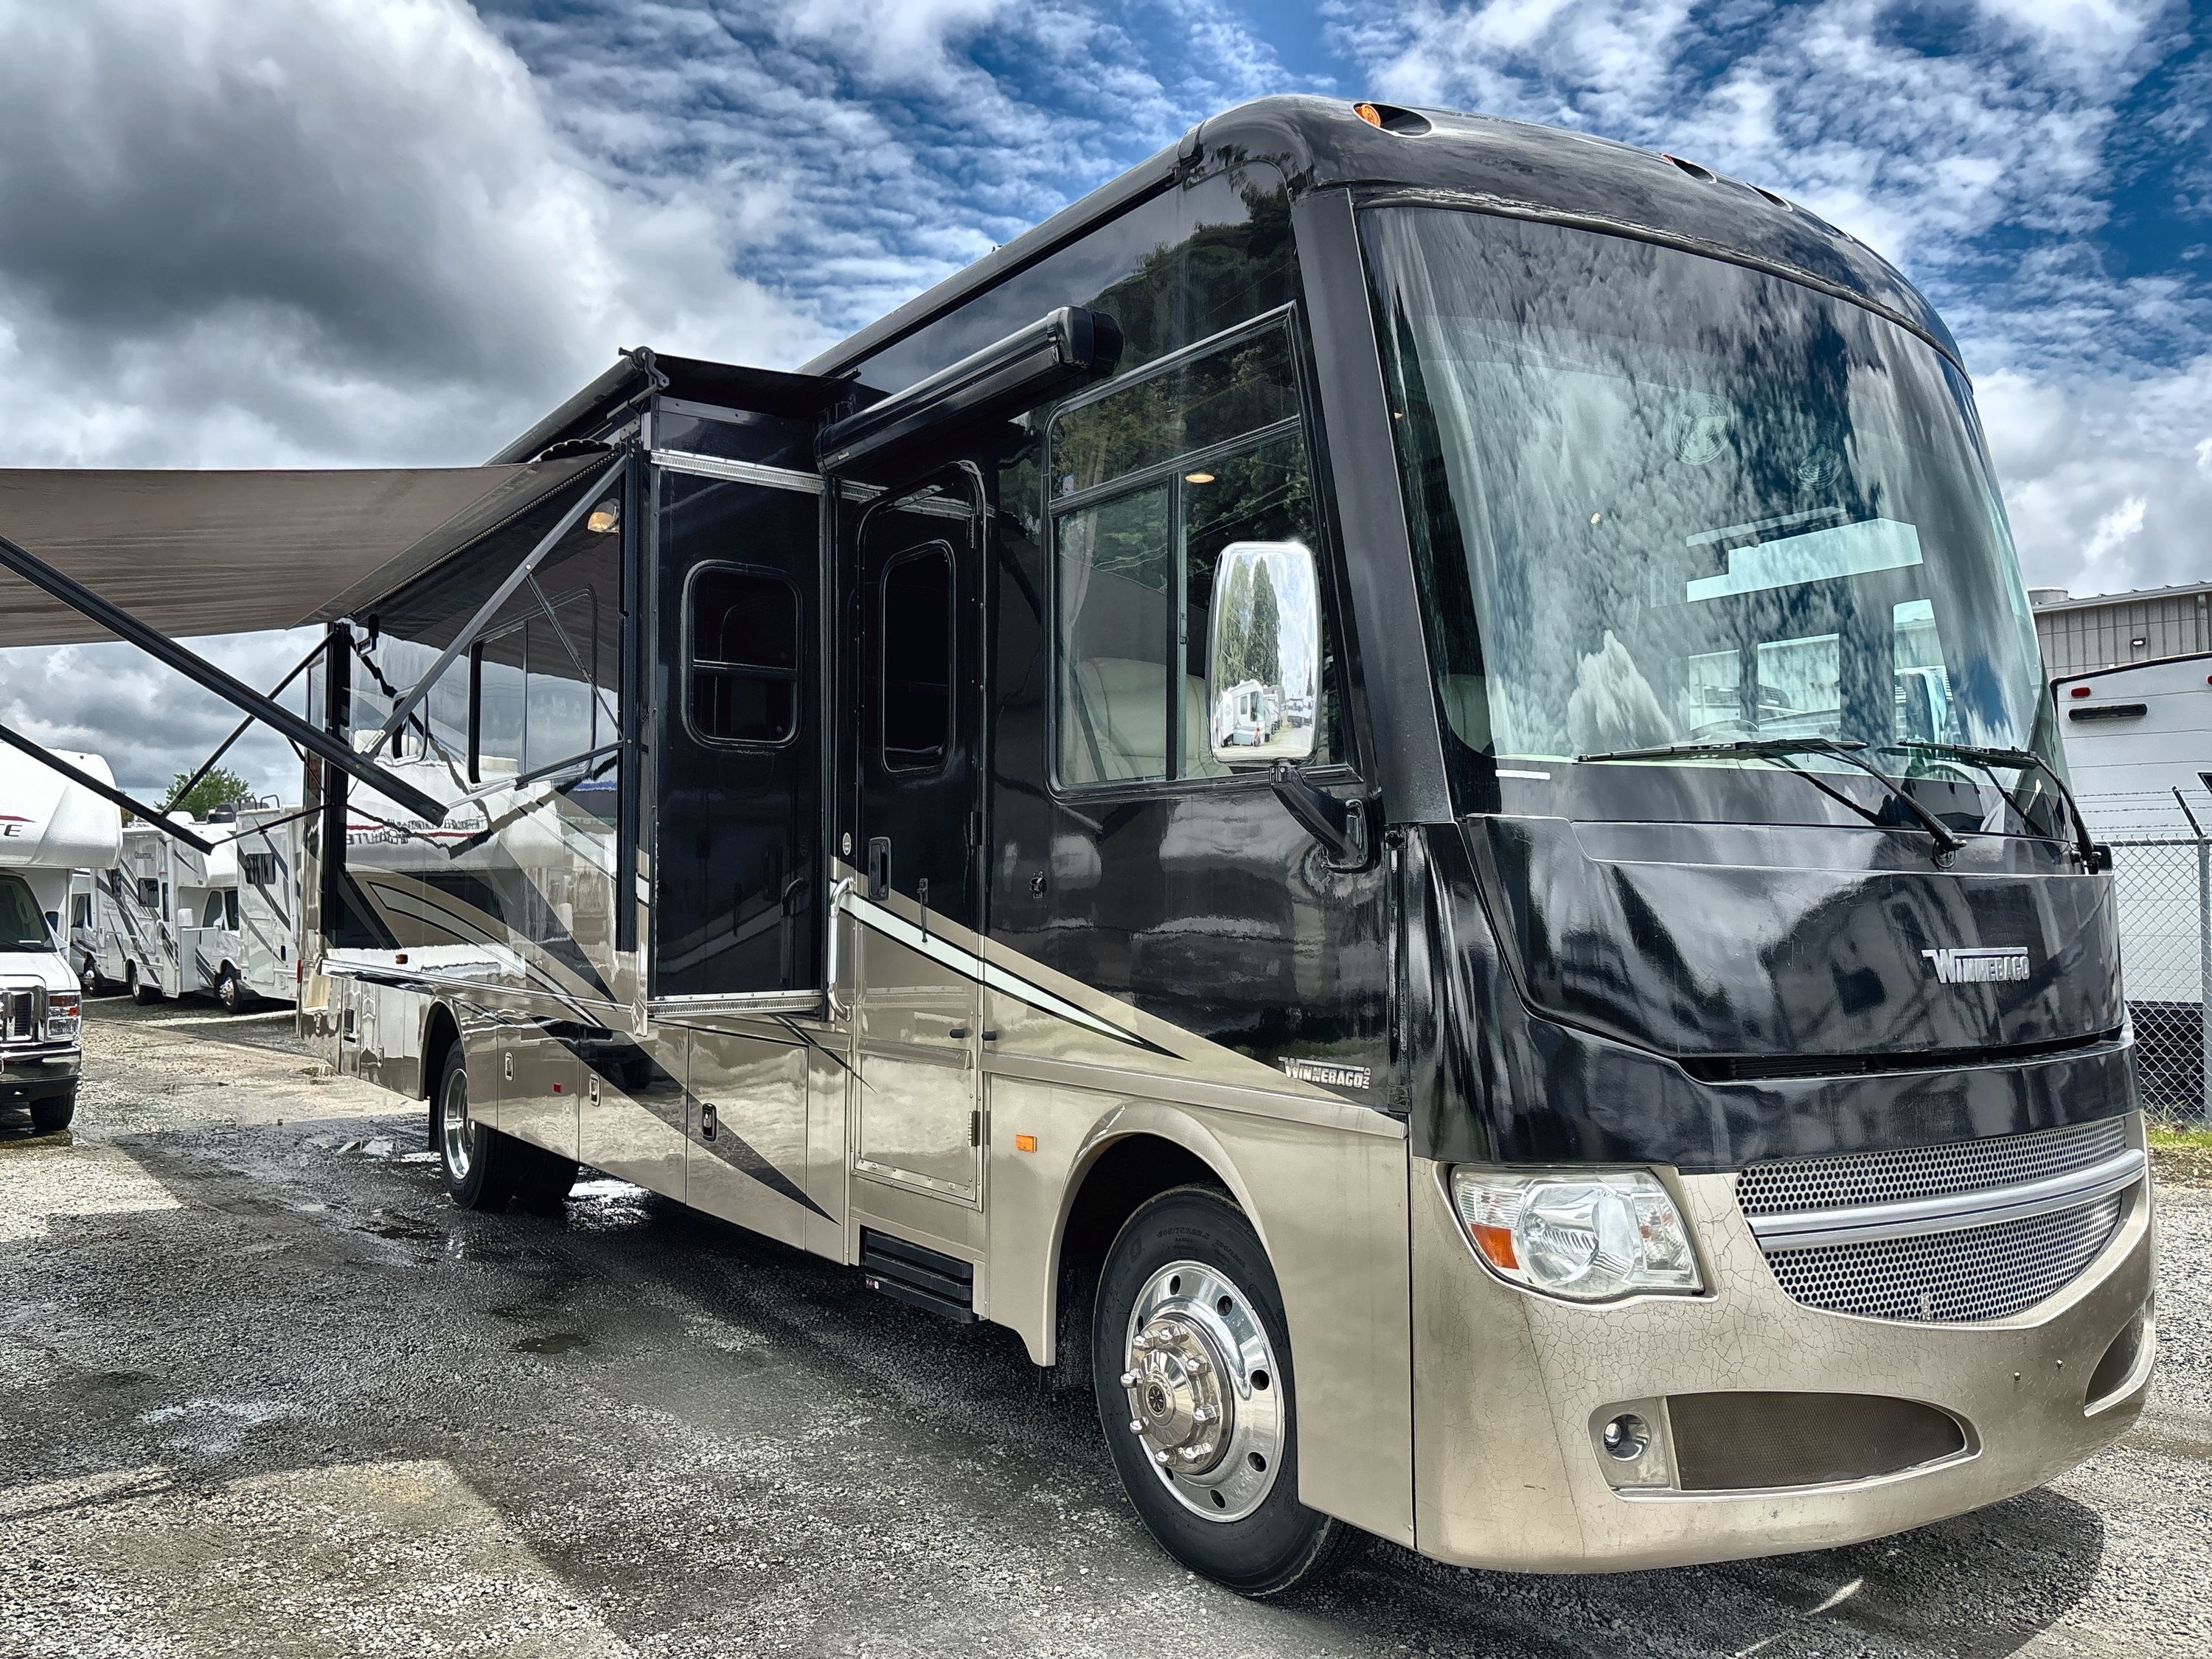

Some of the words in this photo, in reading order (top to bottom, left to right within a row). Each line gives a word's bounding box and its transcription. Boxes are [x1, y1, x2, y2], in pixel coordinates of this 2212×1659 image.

[0, 824, 23, 837] E
[1921, 947, 2031, 984] WINNEBAGO
[1278, 1056, 1364, 1088] WINNEBAGO
[1363, 1067, 1371, 1090] IND
